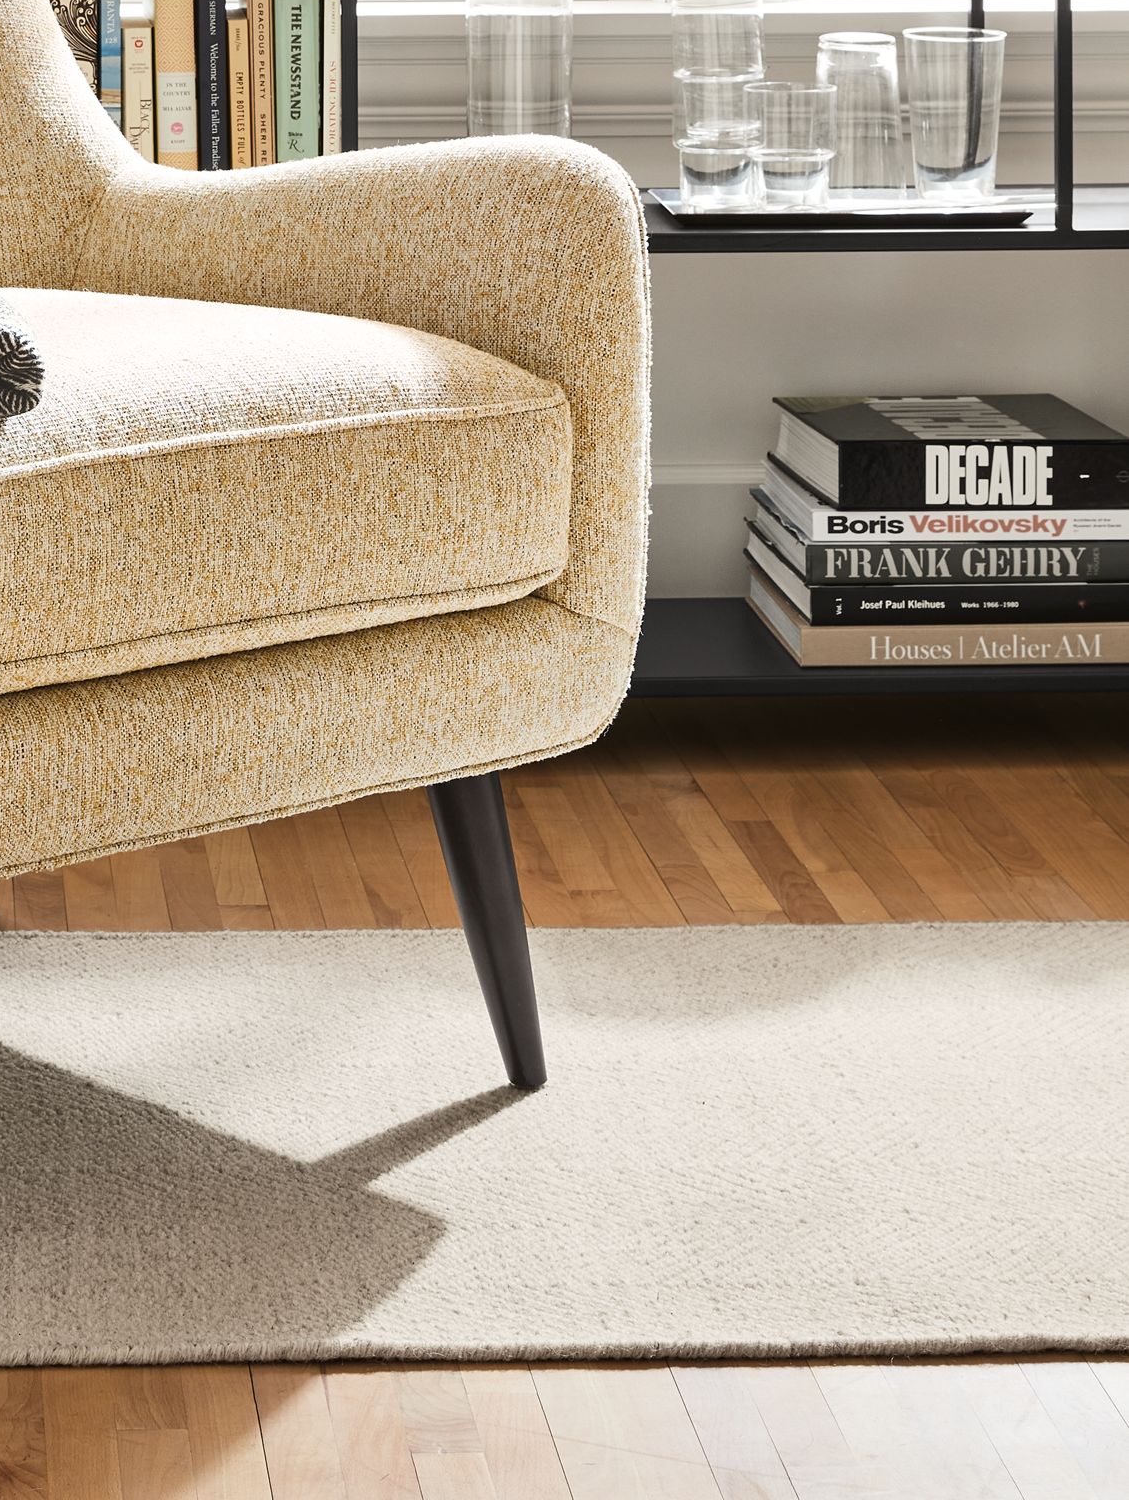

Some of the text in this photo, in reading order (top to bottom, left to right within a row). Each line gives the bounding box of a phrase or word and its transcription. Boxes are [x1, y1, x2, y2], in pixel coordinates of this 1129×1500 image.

[290, 5, 302, 120] THE NEWSSTAND
[236, 72, 244, 94] EMPTY
[210, 44, 221, 170] Welcome to the Fallen Paradise
[236, 100, 244, 132] BOTTLES
[130, 126, 141, 150] DAH
[238, 137, 246, 154] FULL
[925, 444, 1053, 506] DECADE
[827, 514, 1068, 537] Boris Velikovsky
[824, 547, 1086, 578] FRANK GEHRY
[860, 600, 945, 610] Josef Paul Kleihues
[870, 634, 1102, 660] Houses Atelier AM
